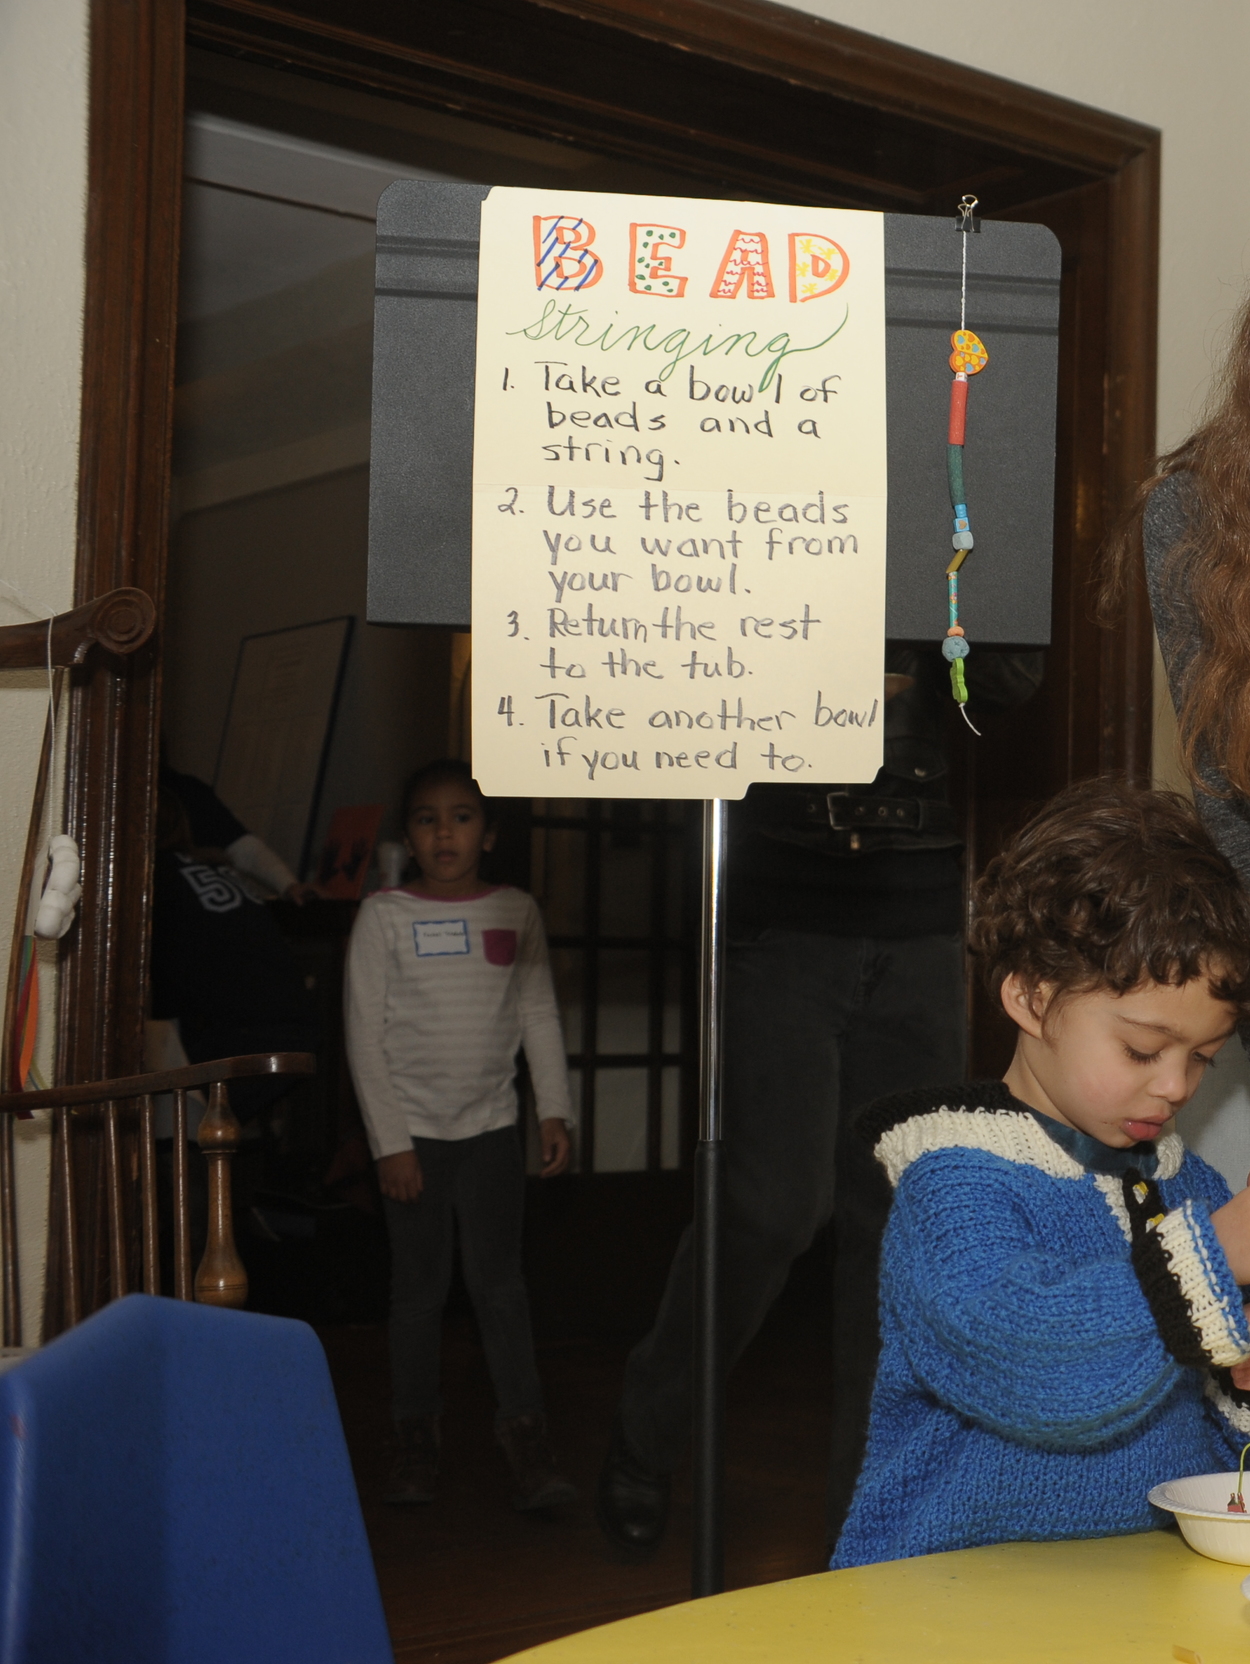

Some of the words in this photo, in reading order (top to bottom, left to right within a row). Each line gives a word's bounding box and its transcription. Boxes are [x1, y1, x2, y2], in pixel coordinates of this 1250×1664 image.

[532, 215, 850, 303] BEAD
[505, 299, 849, 393] Stringing
[502, 367, 515, 390] 1.
[534, 361, 621, 397] Take
[644, 379, 667, 397] a
[689, 365, 783, 404] bowl
[799, 376, 841, 403] of
[546, 401, 666, 431] beads
[700, 411, 774, 437] and
[797, 419, 821, 438] a
[541, 436, 681, 481] string.
[498, 487, 524, 515] 2.
[546, 485, 617, 519] Use
[639, 491, 703, 522] the
[726, 489, 849, 524] beads
[543, 530, 616, 565] you
[640, 531, 743, 559] want
[766, 528, 858, 560] from
[548, 571, 633, 602] your
[651, 564, 751, 594] bowl.
[507, 611, 529, 640] 3.
[547, 603, 648, 643] Return
[651, 605, 717, 641] the
[739, 604, 822, 640] rest
[540, 647, 586, 679] to
[601, 648, 664, 680] the
[681, 647, 753, 679] tub.
[498, 696, 524, 727] 4.
[534, 693, 626, 730] Take
[648, 698, 796, 732] another
[813, 690, 879, 727] bowl
[540, 737, 577, 767] if
[584, 749, 640, 780] you
[655, 742, 738, 769] need
[761, 742, 812, 772] to.
